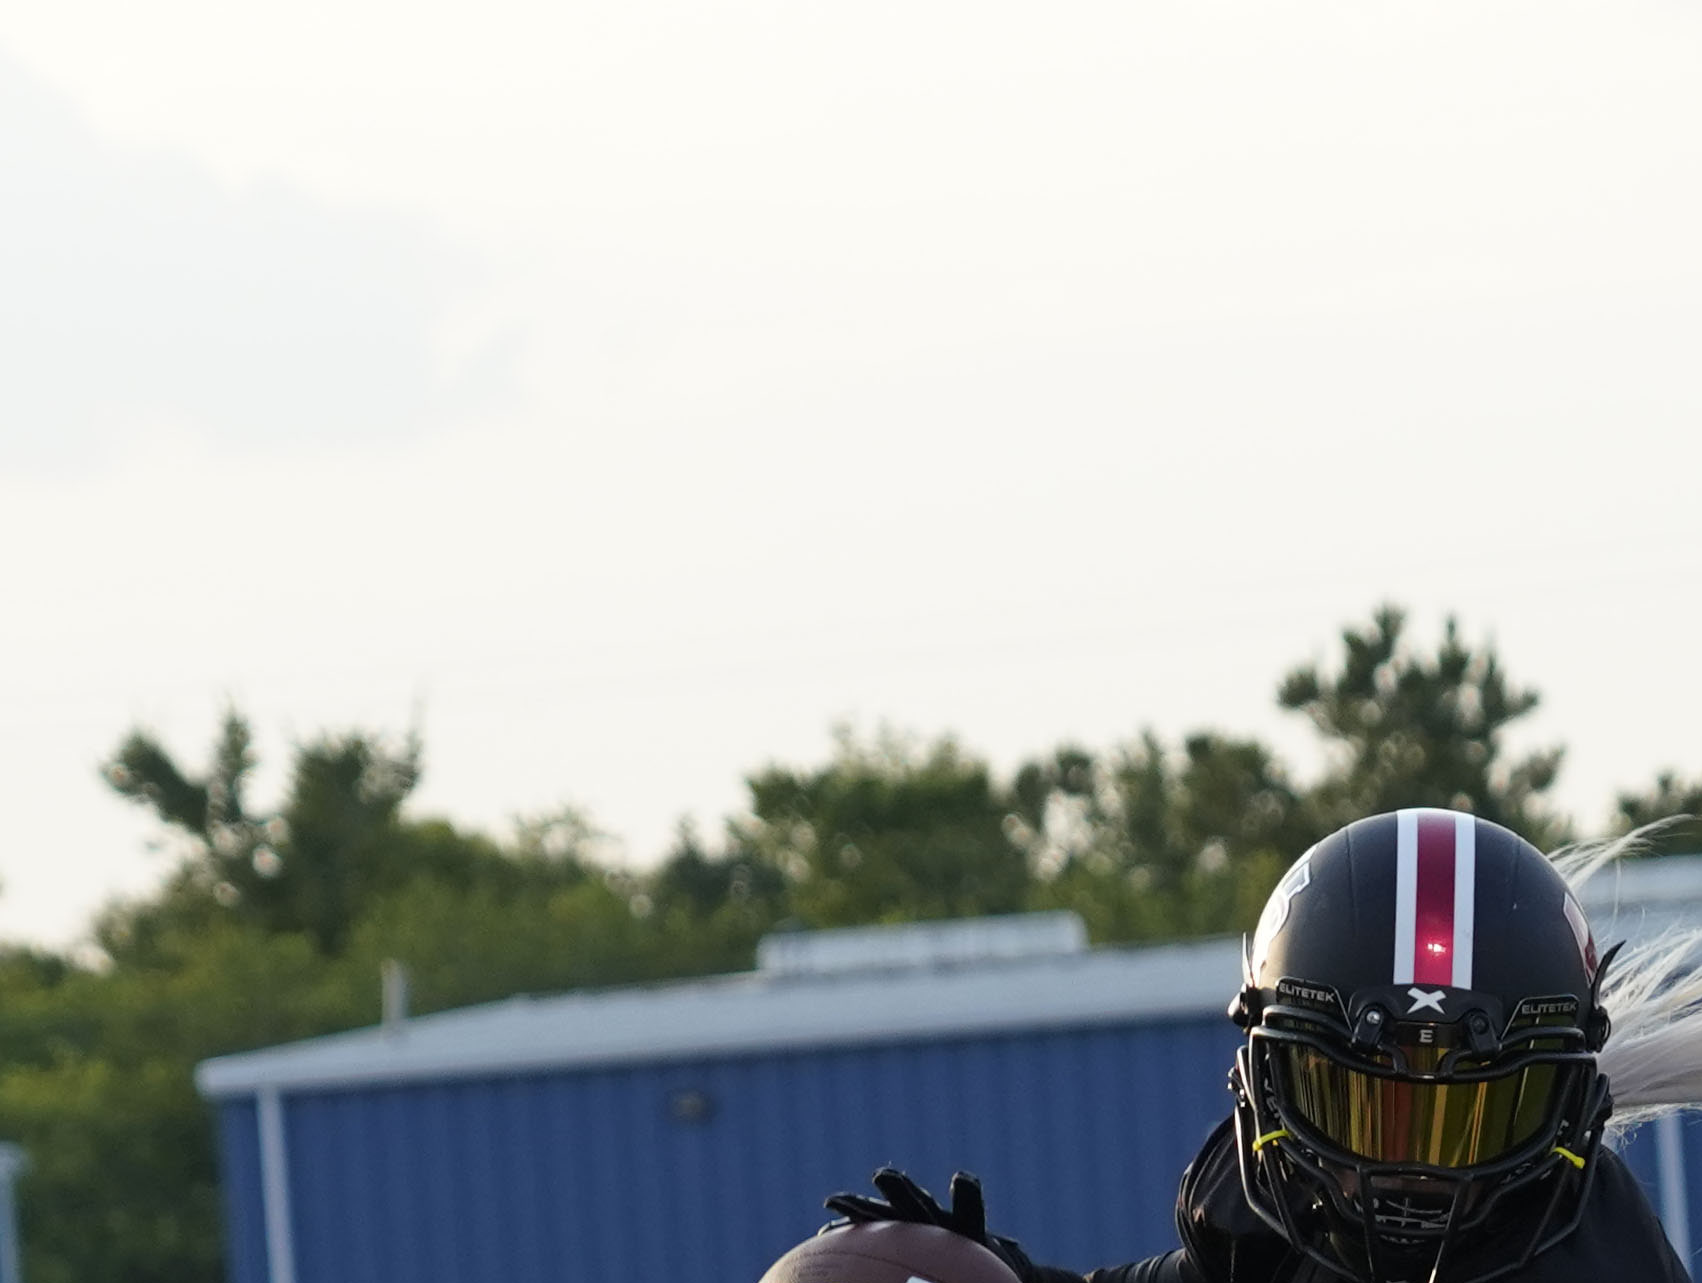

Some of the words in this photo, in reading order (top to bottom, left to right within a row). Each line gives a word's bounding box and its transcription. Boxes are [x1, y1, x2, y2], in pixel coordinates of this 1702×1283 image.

[1279, 982, 1335, 1003] ELITETEK
[1521, 1001, 1577, 1015] ELITETEK
[1419, 1029, 1433, 1043] E
